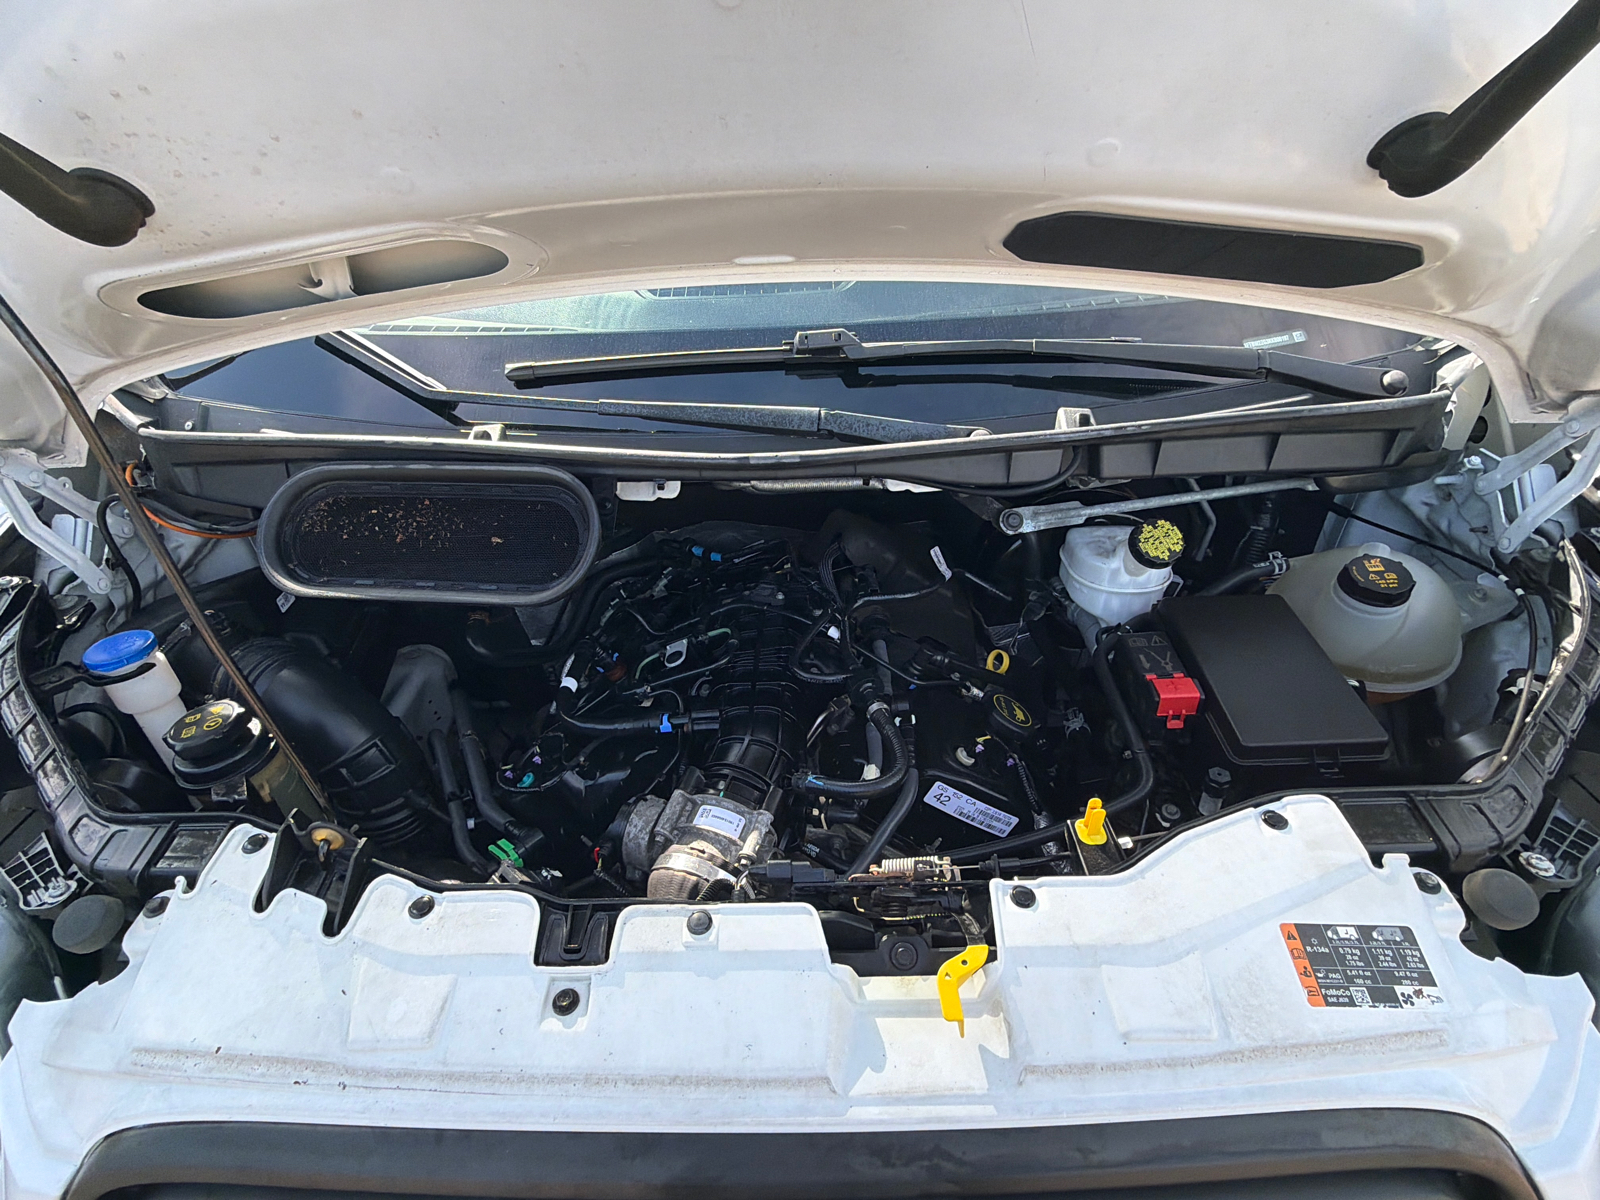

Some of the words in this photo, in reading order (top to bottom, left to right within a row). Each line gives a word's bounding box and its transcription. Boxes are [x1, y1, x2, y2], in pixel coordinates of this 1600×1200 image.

[933, 792, 951, 806] 42
[937, 784, 949, 793] GS
[952, 791, 963, 801] 152
[965, 798, 977, 807] CA
[1305, 945, 1330, 953] R-134a
[1351, 947, 1361, 955] kg
[1384, 948, 1393, 957] kg
[1412, 949, 1420, 957] kg
[1321, 988, 1351, 996] FoMoCo
